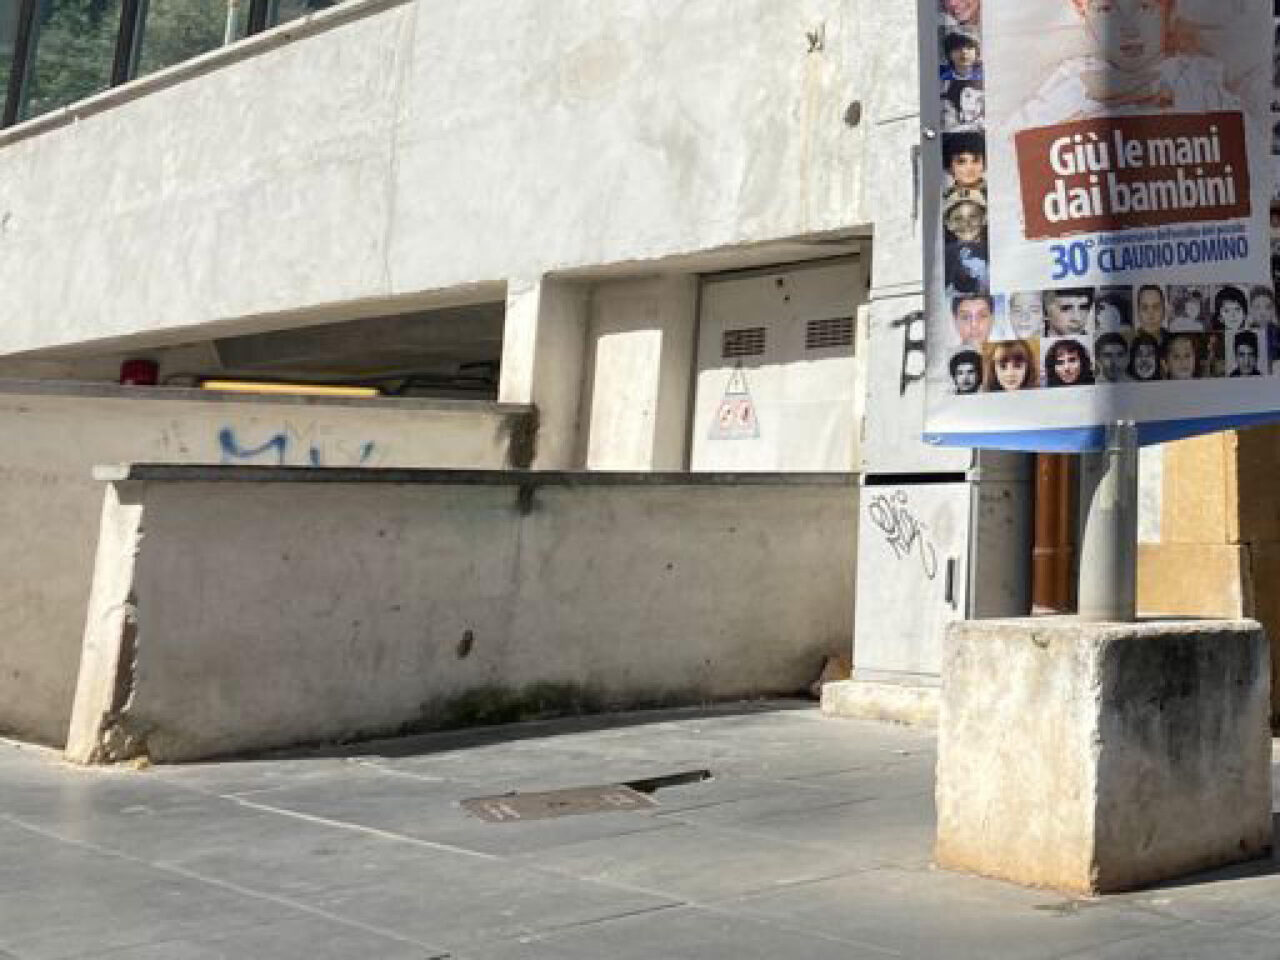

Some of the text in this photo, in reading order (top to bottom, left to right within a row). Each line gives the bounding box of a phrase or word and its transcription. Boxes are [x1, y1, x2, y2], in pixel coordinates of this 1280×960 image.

[1050, 124, 1221, 176] Giù le mani
[1044, 165, 1236, 223] dai bambini
[1098, 241, 1173, 273] CLAUDIO
[1177, 235, 1248, 266] DOMINO
